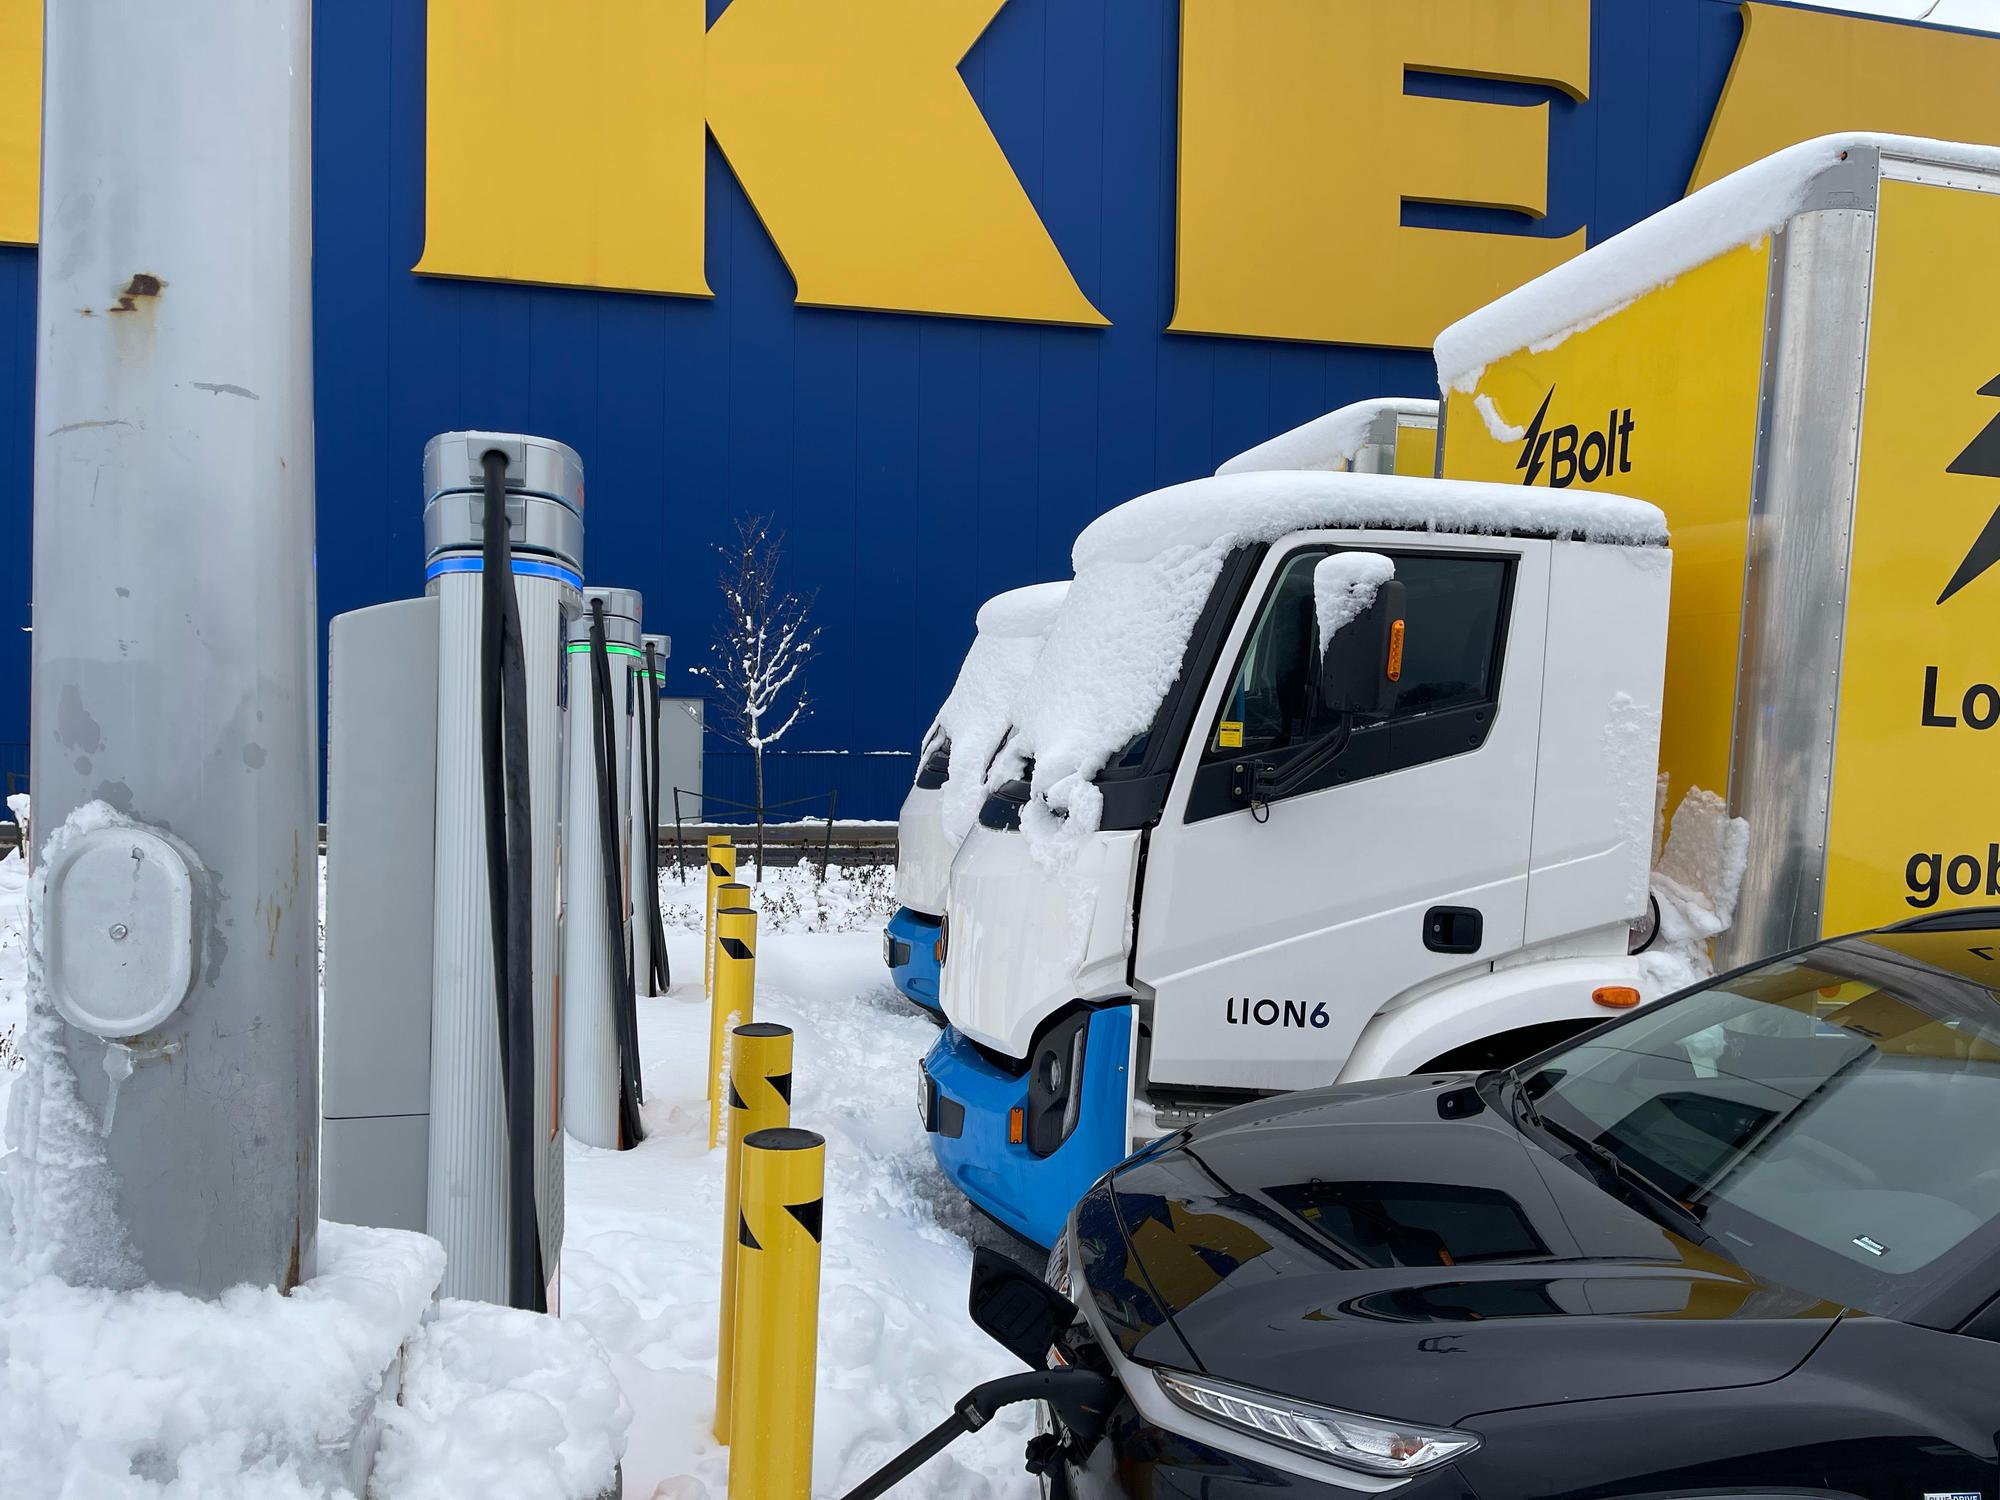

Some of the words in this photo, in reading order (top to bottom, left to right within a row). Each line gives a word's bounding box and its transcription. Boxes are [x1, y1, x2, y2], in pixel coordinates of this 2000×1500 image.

[0, 0, 2000, 347] KE
[1550, 408, 1635, 489] Bolt
[1921, 665, 2000, 730] Lo
[1226, 997, 1330, 1029] LION6
